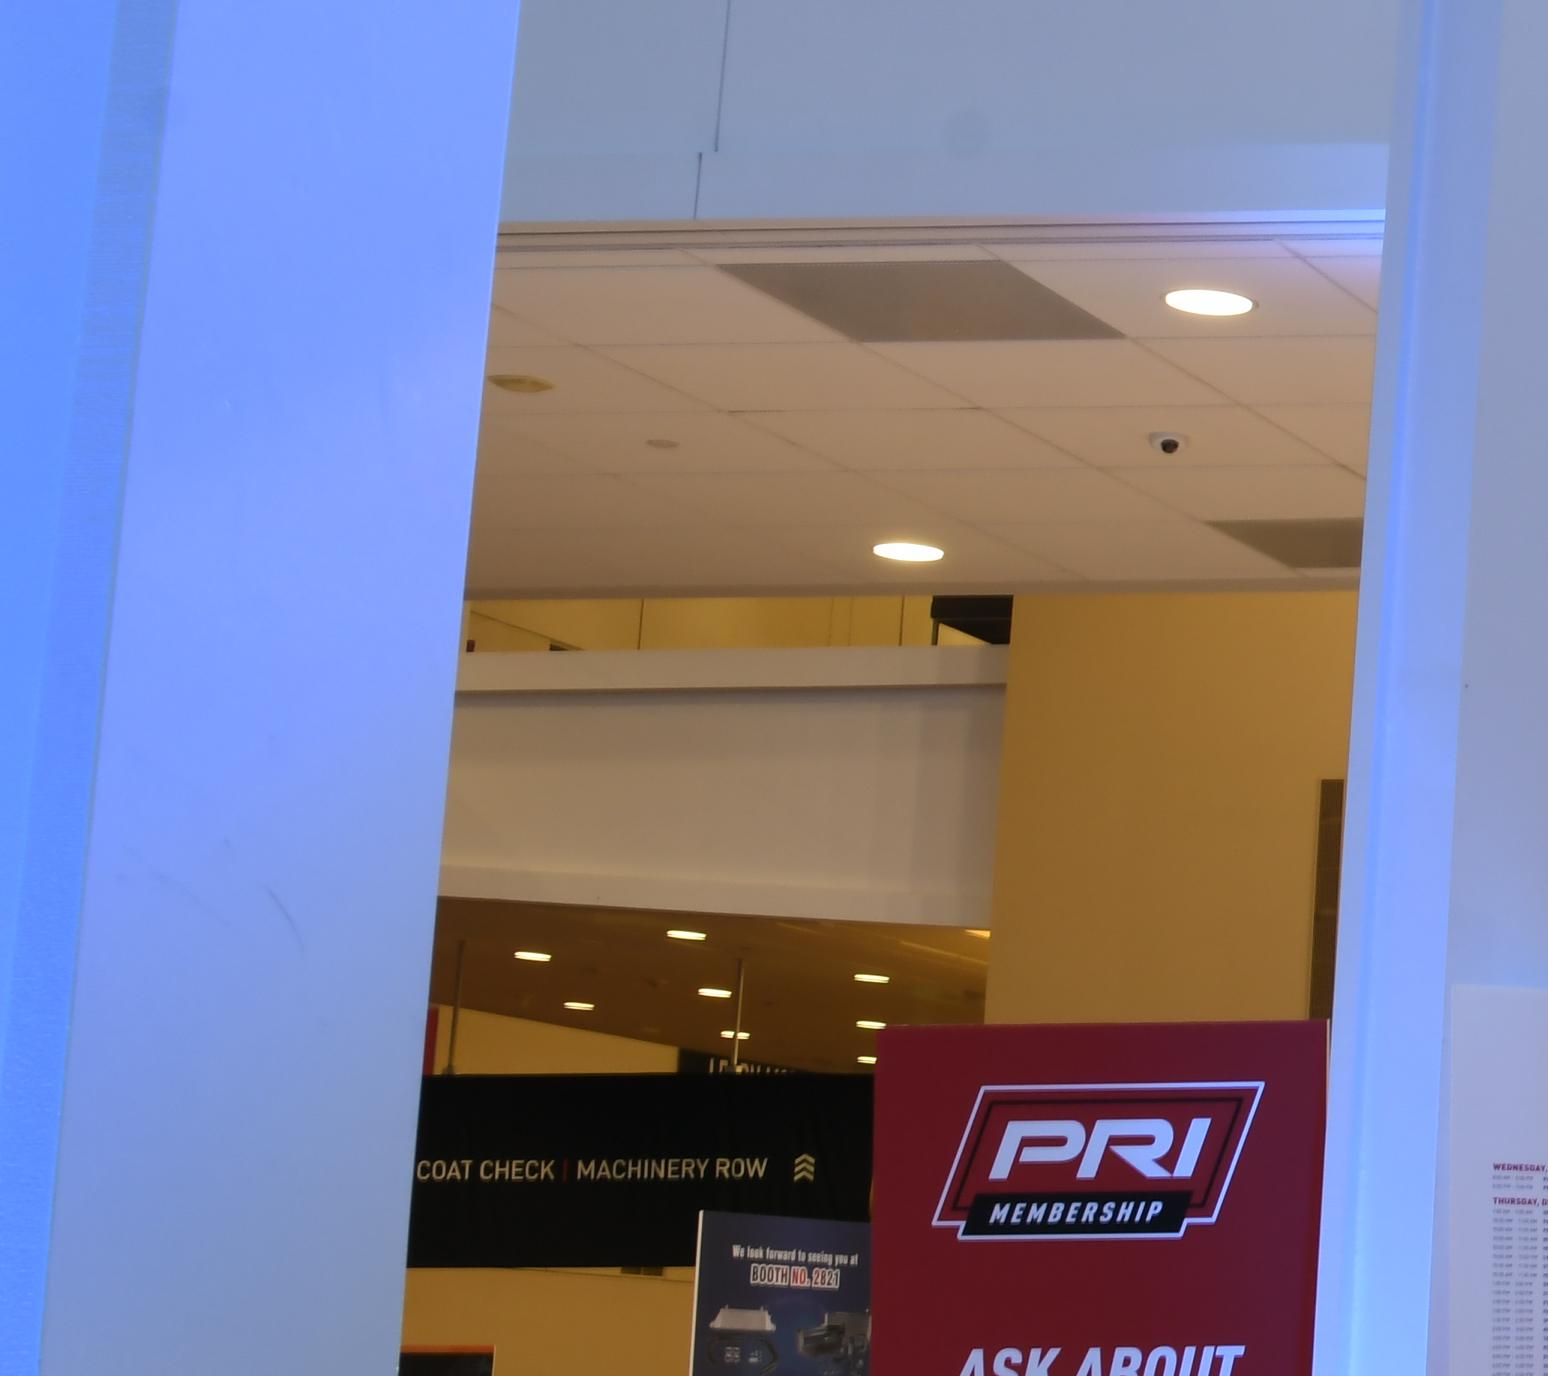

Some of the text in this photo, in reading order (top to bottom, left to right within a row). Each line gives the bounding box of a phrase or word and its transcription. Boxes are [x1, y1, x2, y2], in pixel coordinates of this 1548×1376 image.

[988, 1117, 1212, 1181] PRI
[416, 1156, 768, 1182] COAT CHECK MACHINERY ROW
[1492, 1162, 1548, 1174] WEDNESDAY,
[989, 1200, 1164, 1225] MEMBERSHIP
[1492, 1196, 1540, 1207] THURSDAY,
[751, 1264, 789, 1286] BOOTH
[790, 1266, 811, 1288] NO.
